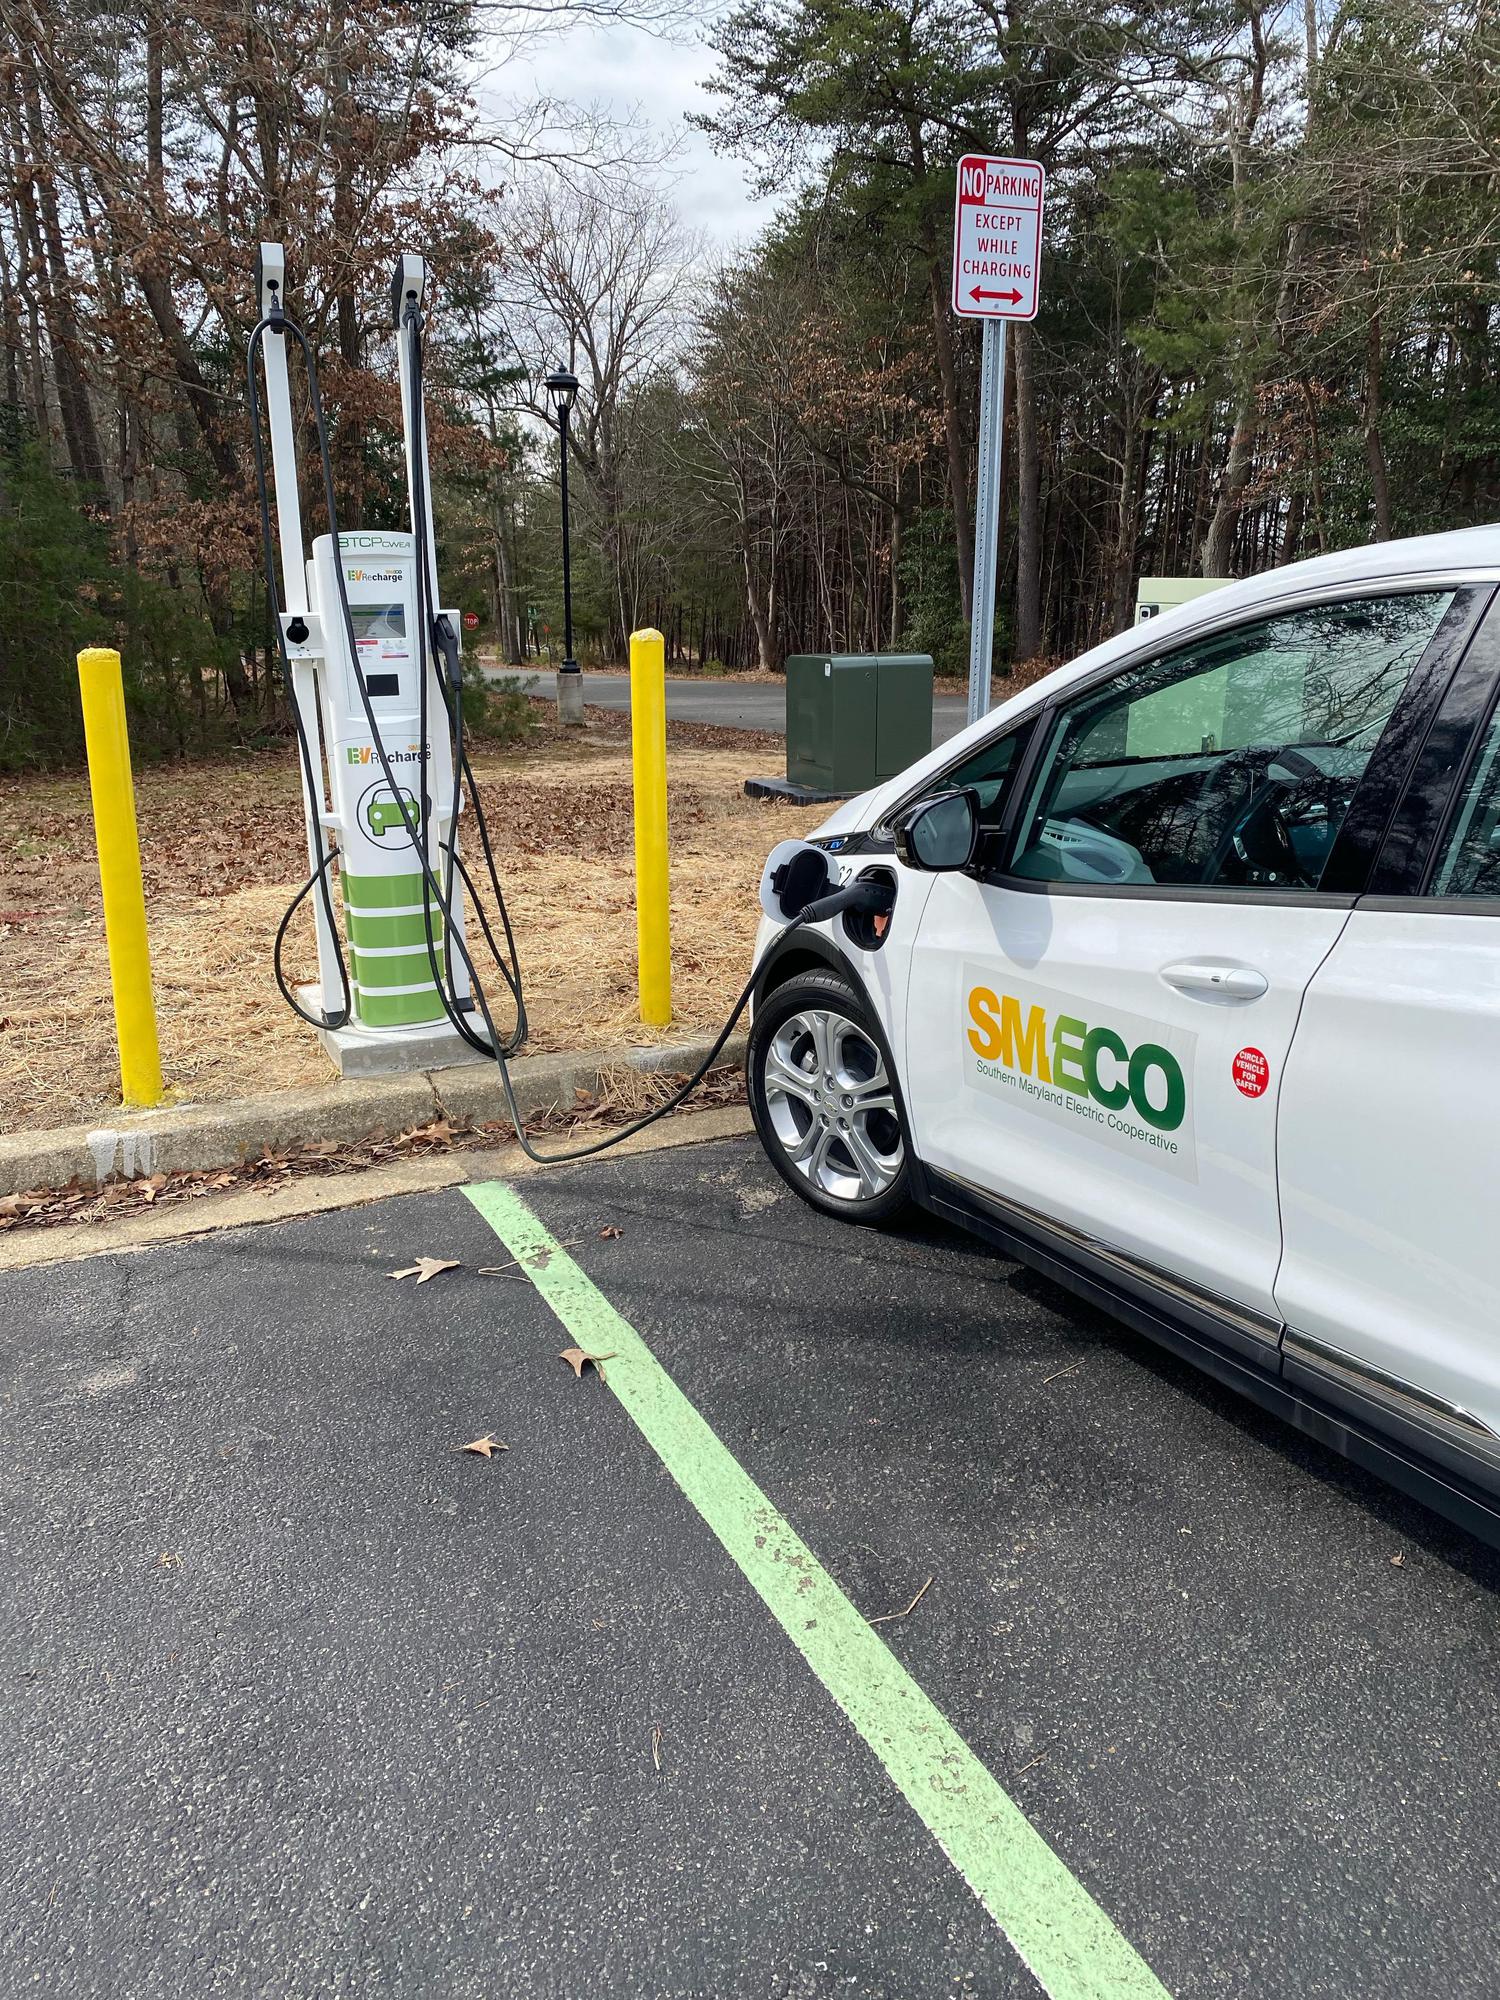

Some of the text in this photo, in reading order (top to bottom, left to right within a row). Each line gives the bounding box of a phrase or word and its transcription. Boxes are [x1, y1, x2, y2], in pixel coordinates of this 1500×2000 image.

[961, 166, 1039, 199] NO PARKING
[975, 213, 1022, 231] EXCEPT
[977, 237, 1018, 255] WHILE
[963, 259, 1031, 279] CHARGING
[967, 986, 1186, 1132] SMECO
[1239, 1050, 1265, 1065] CIRCLE
[1236, 1059, 1265, 1075] VEHICLE
[1242, 1070, 1256, 1082] FOR
[1235, 1078, 1262, 1093] SAFETY
[976, 1059, 1178, 1154] Southern Maryland Electric Cooperative
